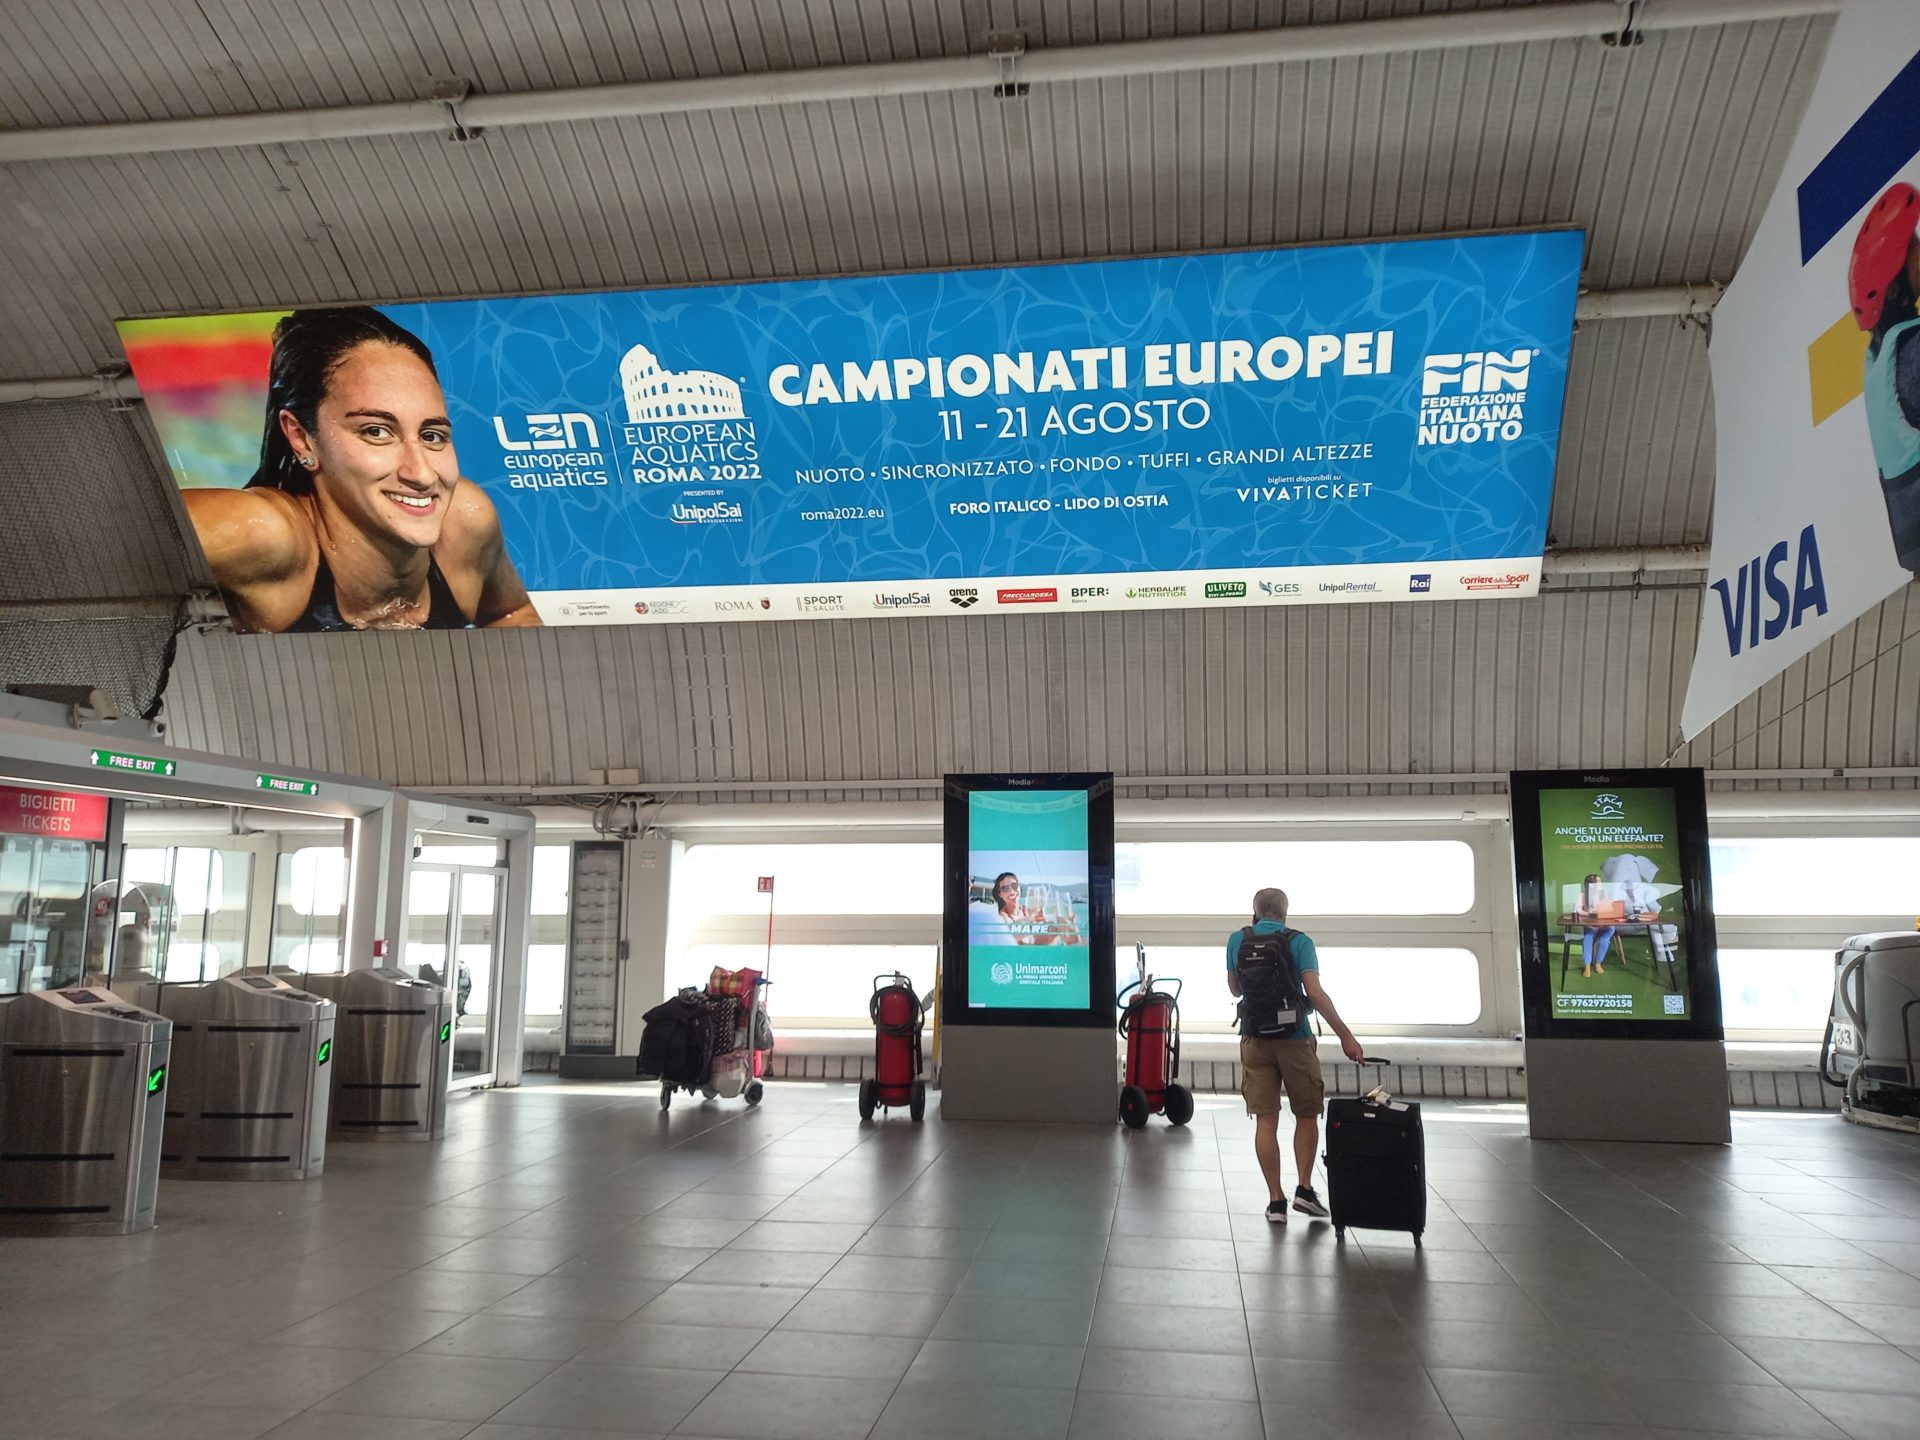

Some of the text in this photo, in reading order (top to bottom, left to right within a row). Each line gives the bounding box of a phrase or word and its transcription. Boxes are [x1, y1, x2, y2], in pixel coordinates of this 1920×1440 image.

[769, 330, 1394, 407] CAMPIONATI EUROPEI
[1422, 350, 1531, 396] FIN
[1421, 392, 1526, 409] FEDERAZIONE
[938, 409, 963, 441] 11
[996, 406, 1029, 438] 21
[1041, 397, 1211, 437] AGOSTO
[1420, 404, 1523, 425] ITALIANA
[493, 413, 600, 451] LEN
[624, 422, 756, 446] EUROPEAN
[1418, 420, 1523, 446] NUOTO
[504, 452, 604, 470] european
[631, 441, 758, 467] AQUATICS
[795, 443, 1374, 484] NUOTO SINCRONIZZATO FONDO TUFFI GRANDI ALTEZZE
[508, 467, 608, 491] aquatics
[633, 464, 762, 484] ROMA 2022
[1267, 475, 1294, 484] biglietti
[1296, 473, 1332, 483] disponibili
[1236, 482, 1373, 503] VIVATICKET
[950, 502, 990, 515] FORO
[994, 499, 1050, 513] ITALICO
[1064, 497, 1100, 511] LIDO
[1104, 496, 1119, 509] DI
[1123, 494, 1169, 508] OSTIA
[672, 502, 742, 523] UnipolSai
[801, 507, 884, 521] roma2022.eu
[1411, 579, 1430, 589] Rai
[1460, 575, 1493, 584] Corriere
[1505, 574, 1529, 585] Sport
[949, 588, 978, 596] arena
[1138, 585, 1187, 593] HERBALIFE
[1207, 583, 1244, 592] ULIVETO
[1274, 584, 1299, 593] GES
[1319, 582, 1376, 593] UnipolRental
[1710, 523, 1828, 657] VISA
[804, 595, 843, 605] SPORT
[875, 592, 931, 608] UnipolSai
[1001, 592, 1054, 600] FRECCIAROSSA
[715, 601, 754, 612] ROMA
[109, 756, 156, 771] FREE EXIT
[269, 778, 305, 791] FREE EXIT
[20, 793, 76, 812] BIGLIETTI
[1593, 796, 1623, 809] ITACA
[22, 814, 71, 832] TICKETS
[1555, 826, 1643, 835] ANCHE TU CONVIVI
[1575, 834, 1664, 843] CON UN ELEFANTE?
[1010, 924, 1048, 934] MARE
[1015, 962, 1067, 974] Unimarconi
[1557, 999, 1632, 1007] CF 97629720158
